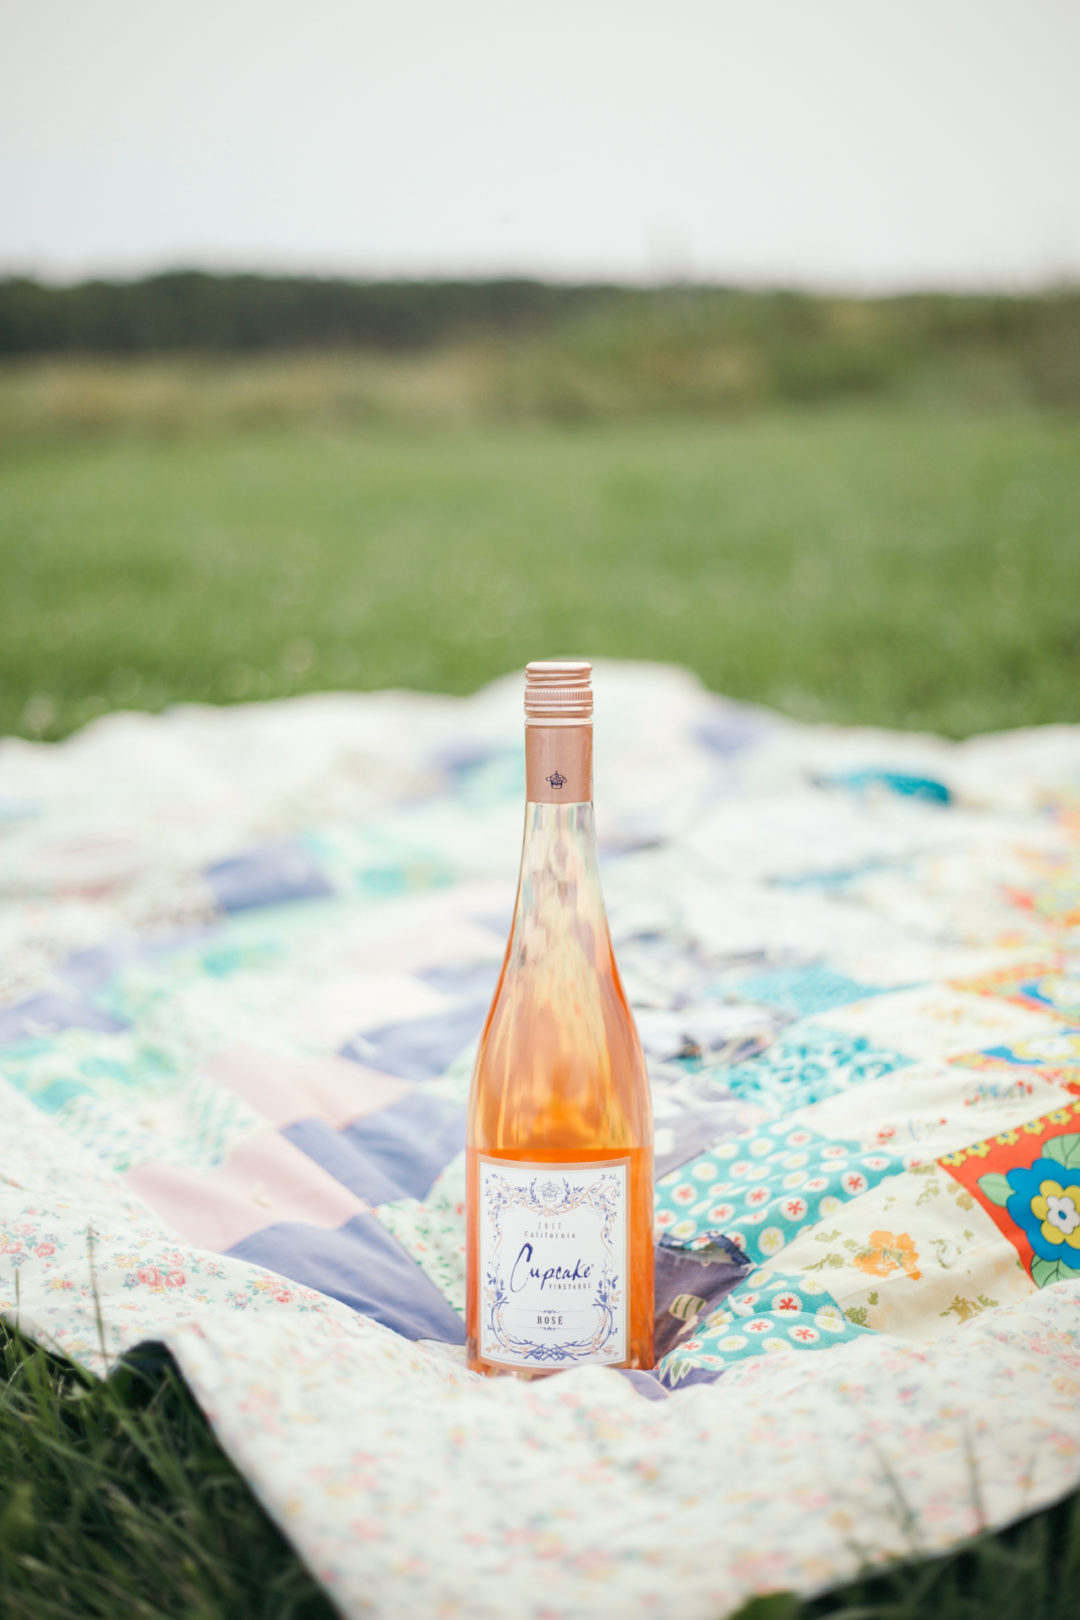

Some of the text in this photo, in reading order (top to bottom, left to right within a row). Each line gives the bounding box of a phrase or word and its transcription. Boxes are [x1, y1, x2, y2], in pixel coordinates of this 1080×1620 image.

[524, 1230, 576, 1239] California
[510, 1242, 591, 1292] Cupcake
[549, 1282, 591, 1290] VINEYARDS
